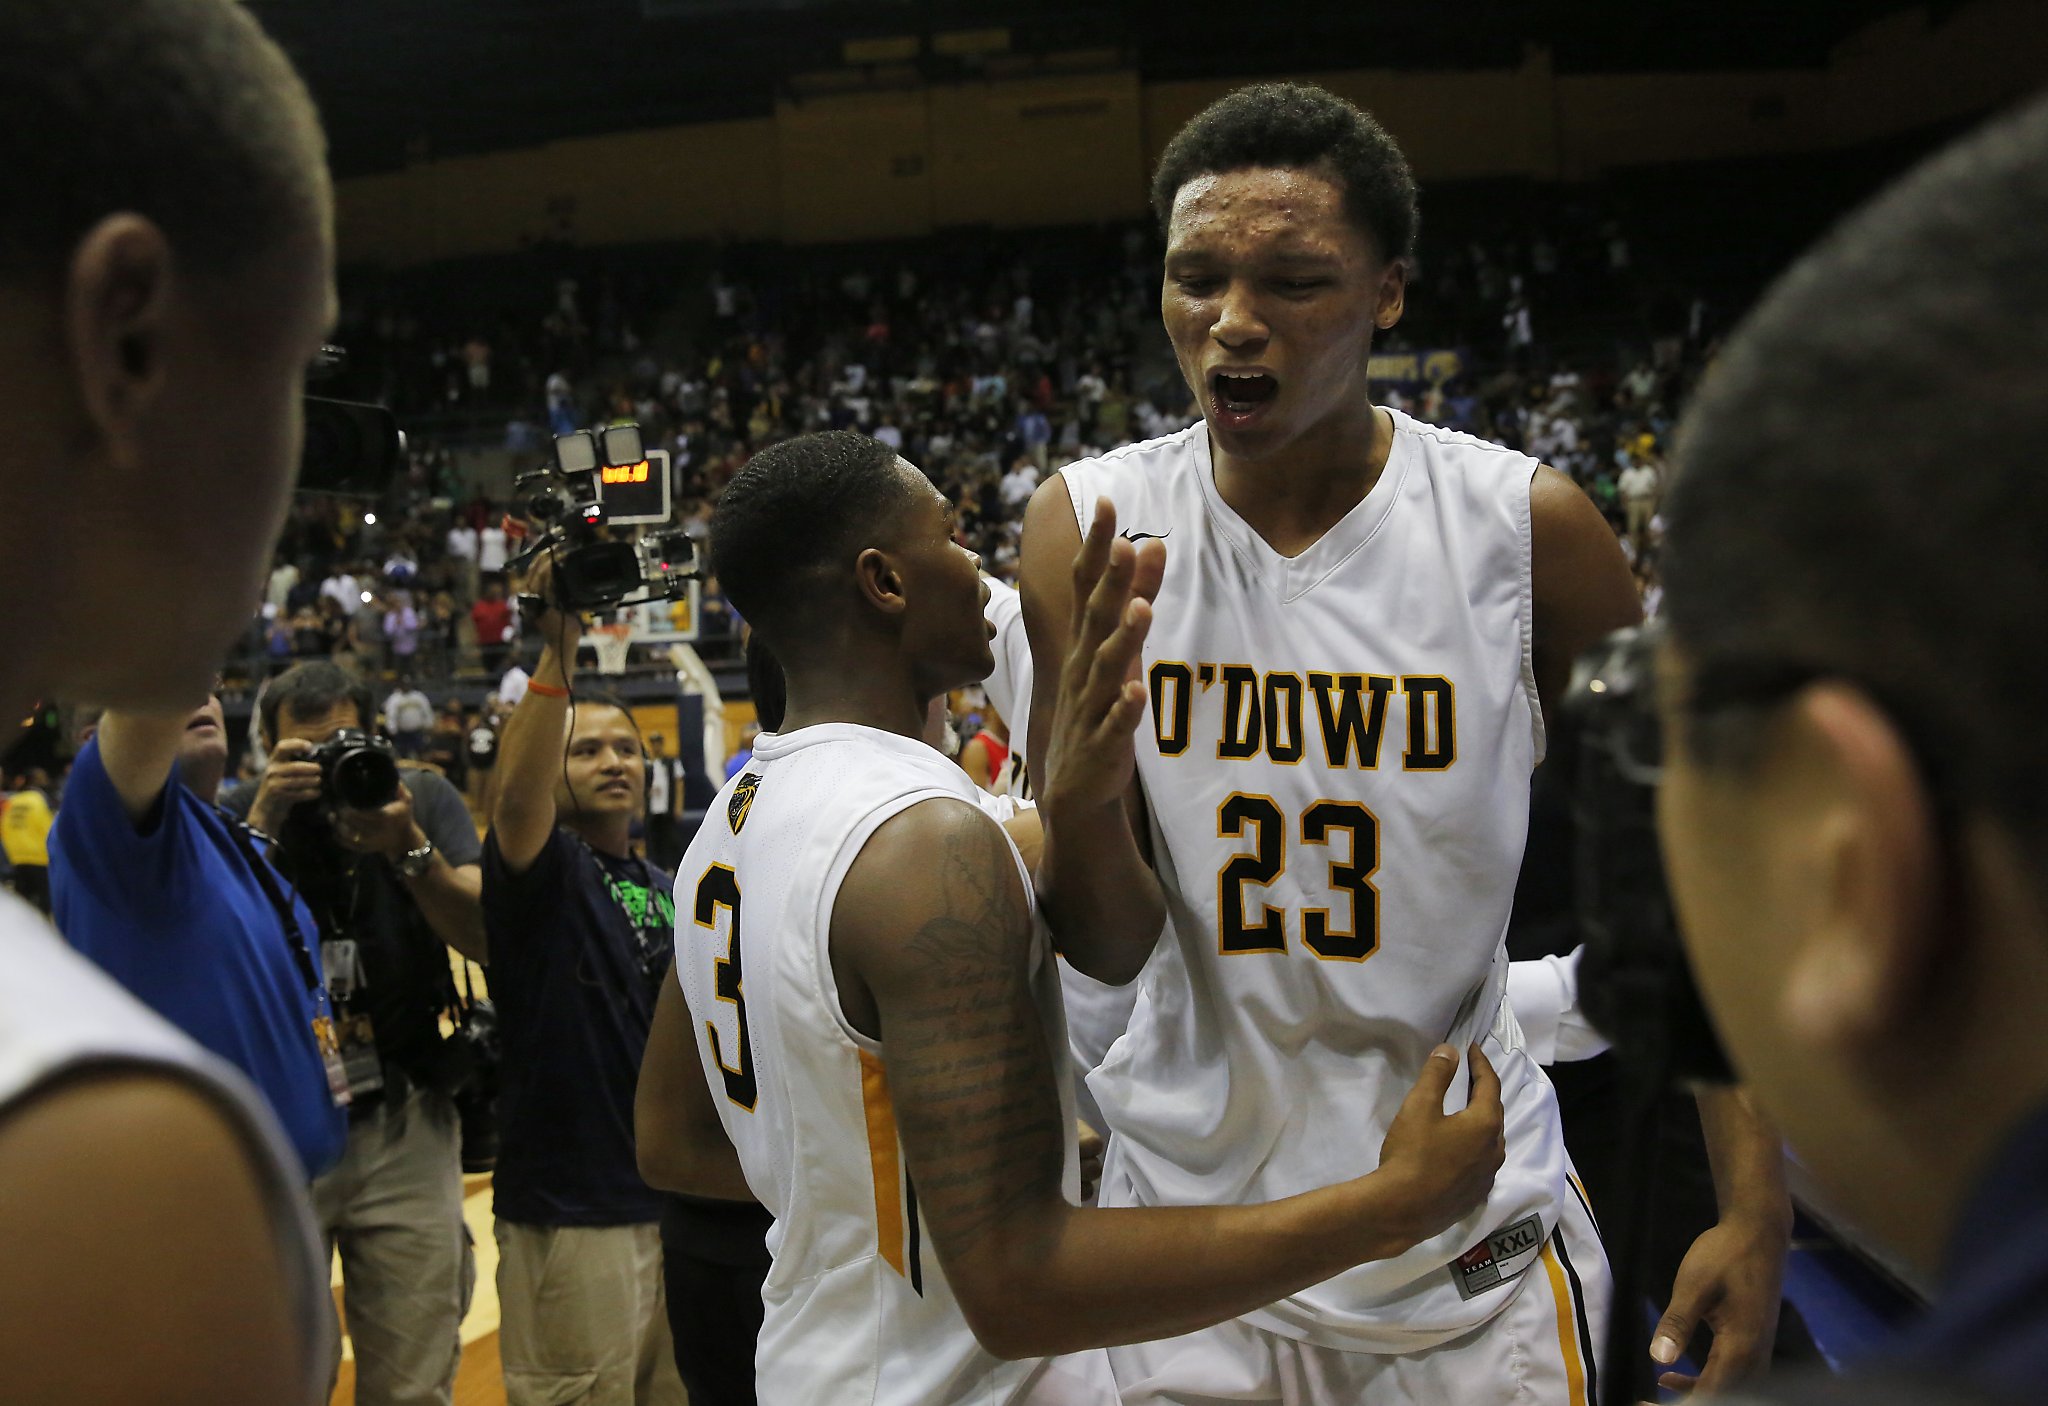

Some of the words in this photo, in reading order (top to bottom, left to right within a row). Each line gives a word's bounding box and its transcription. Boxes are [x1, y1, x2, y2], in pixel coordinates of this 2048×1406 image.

[1148, 660, 1457, 771] O'DOWD
[1217, 791, 1380, 963] 23
[694, 861, 758, 1114] 3
[1465, 1259, 1492, 1274] TEAM
[1493, 1230, 1534, 1256] XXL
